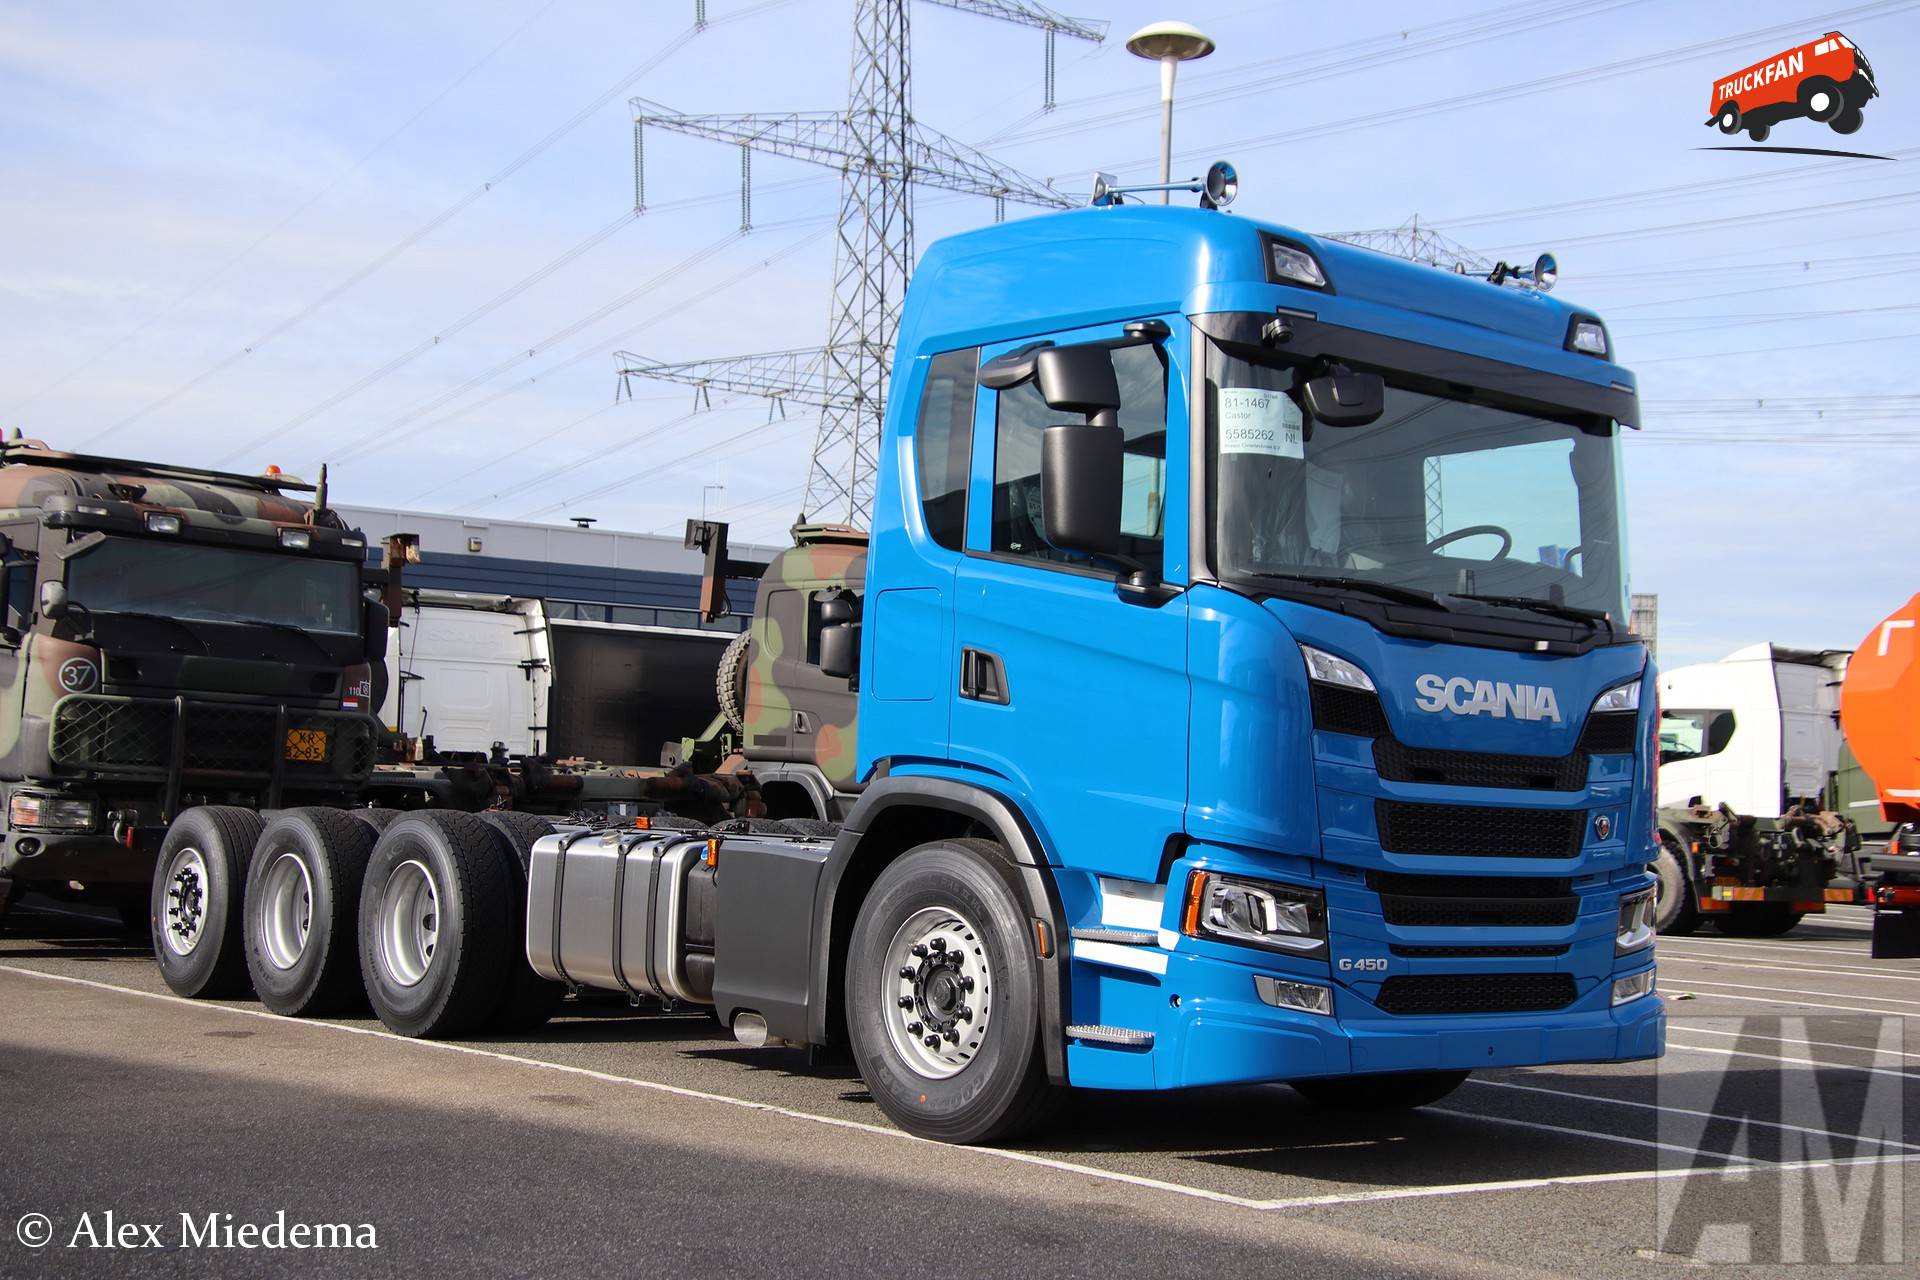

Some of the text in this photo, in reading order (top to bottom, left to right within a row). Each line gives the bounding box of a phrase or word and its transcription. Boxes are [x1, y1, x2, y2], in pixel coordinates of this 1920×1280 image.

[1224, 397, 1271, 408] 81-1467
[1225, 428, 1274, 441] 5585262
[1285, 432, 1299, 445] NL
[64, 665, 92, 686] 37
[349, 686, 360, 696] 110
[1415, 673, 1561, 722] SCANIA
[1339, 958, 1388, 971] G 450
